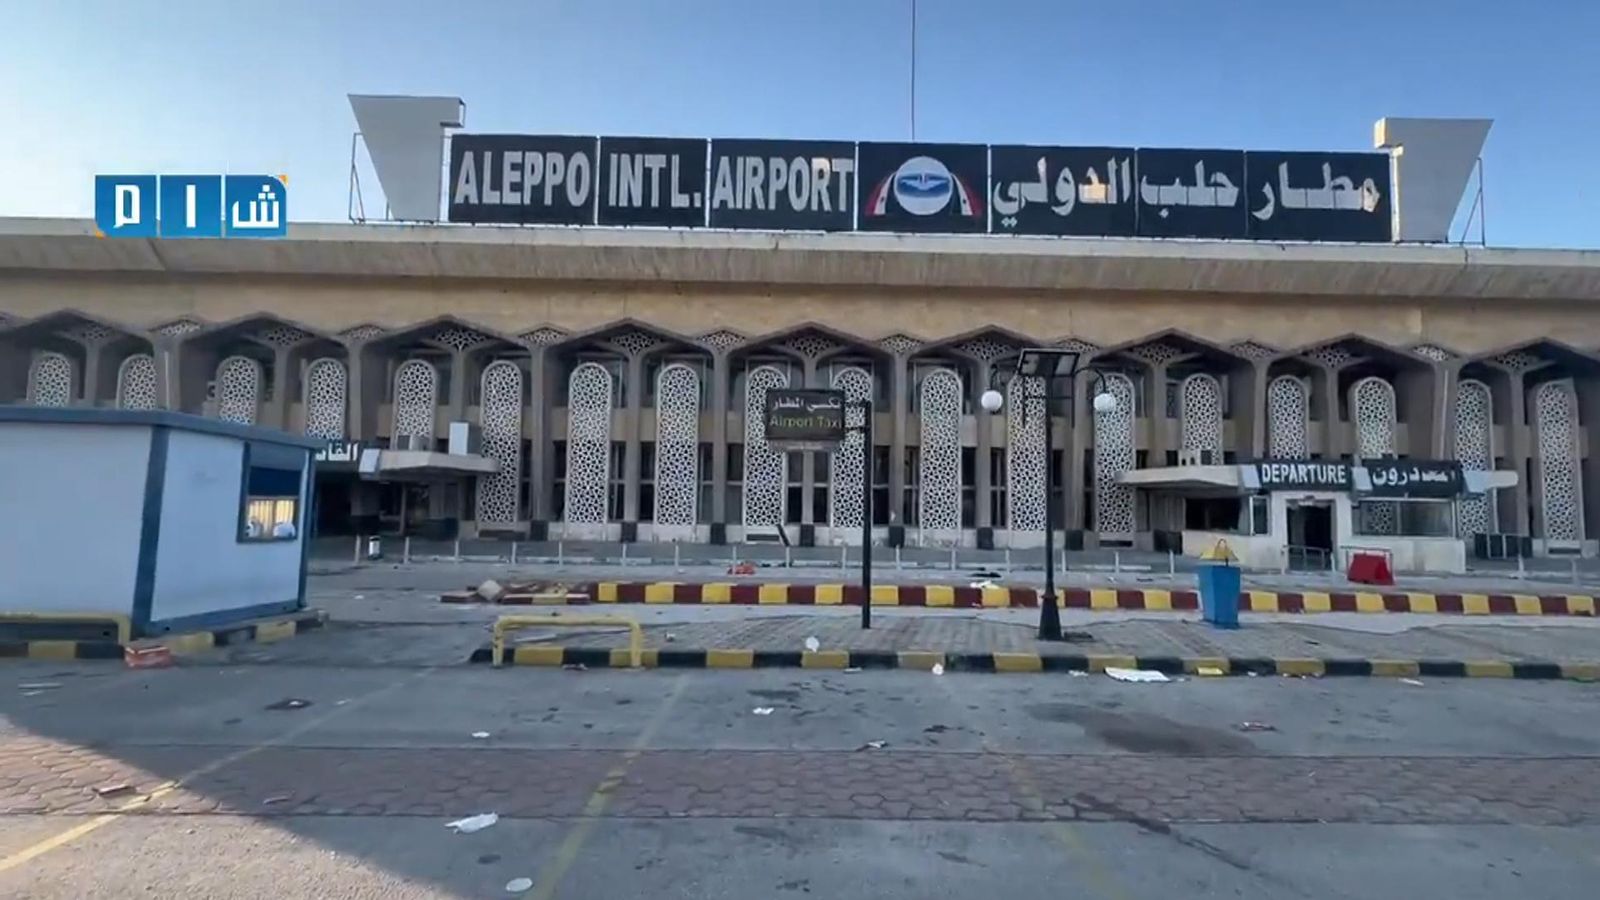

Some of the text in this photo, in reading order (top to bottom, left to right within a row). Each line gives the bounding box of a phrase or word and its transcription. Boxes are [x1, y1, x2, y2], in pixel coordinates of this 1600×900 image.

[454, 151, 854, 212] ALEPPO INTL. AIRPORT
[993, 156, 1381, 228] مطار حلب الدولي
[769, 415, 842, 430] Airport Taxi
[1261, 463, 1347, 485] DEPARTURE
